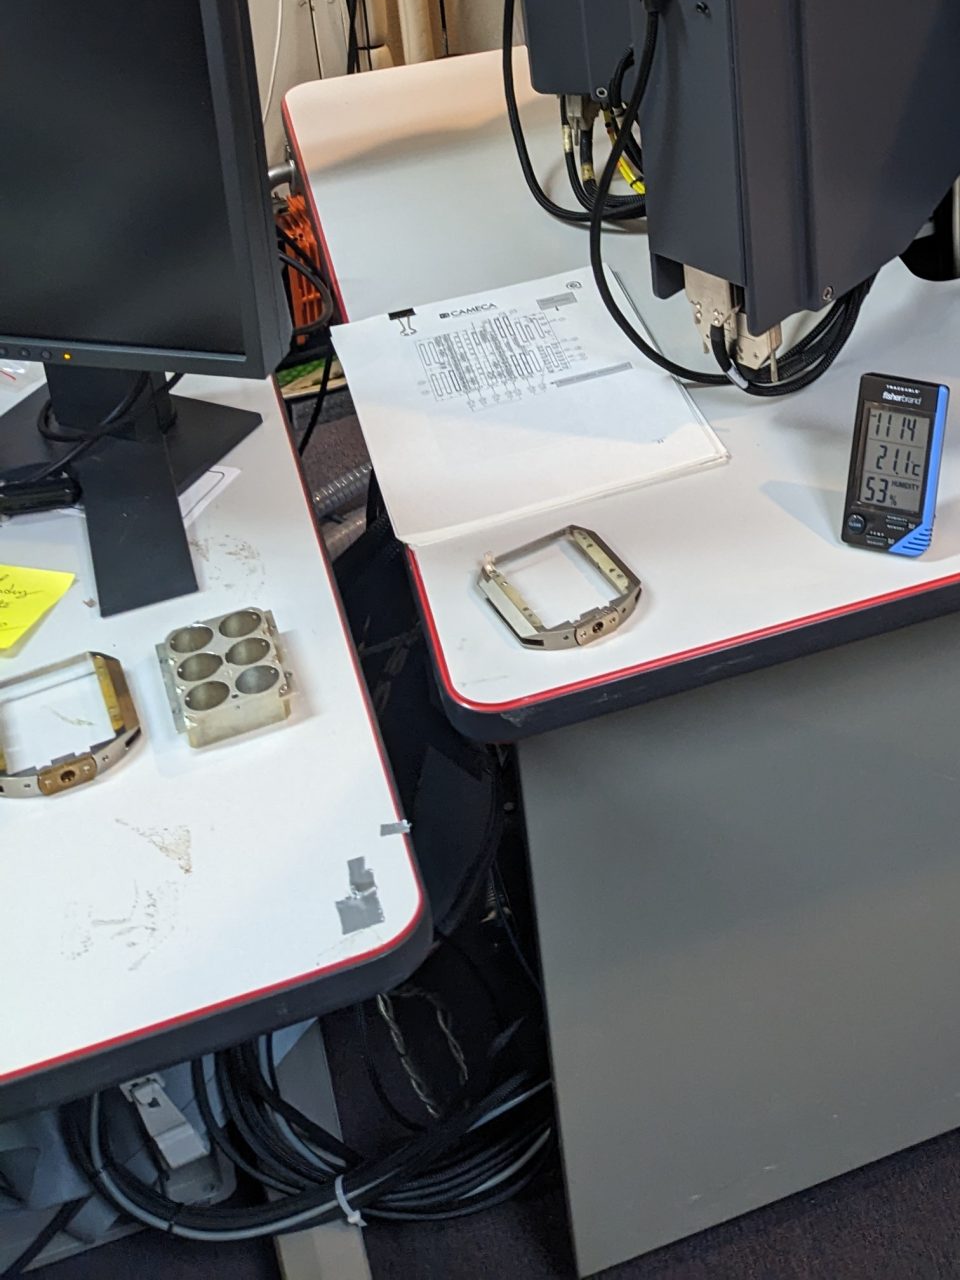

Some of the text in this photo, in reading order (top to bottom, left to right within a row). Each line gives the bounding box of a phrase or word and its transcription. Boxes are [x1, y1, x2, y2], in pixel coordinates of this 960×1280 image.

[451, 303, 497, 317] CAMECA
[882, 391, 922, 405] fisherbrand
[864, 476, 889, 503] 53
[892, 480, 920, 491] HUMIDITY
